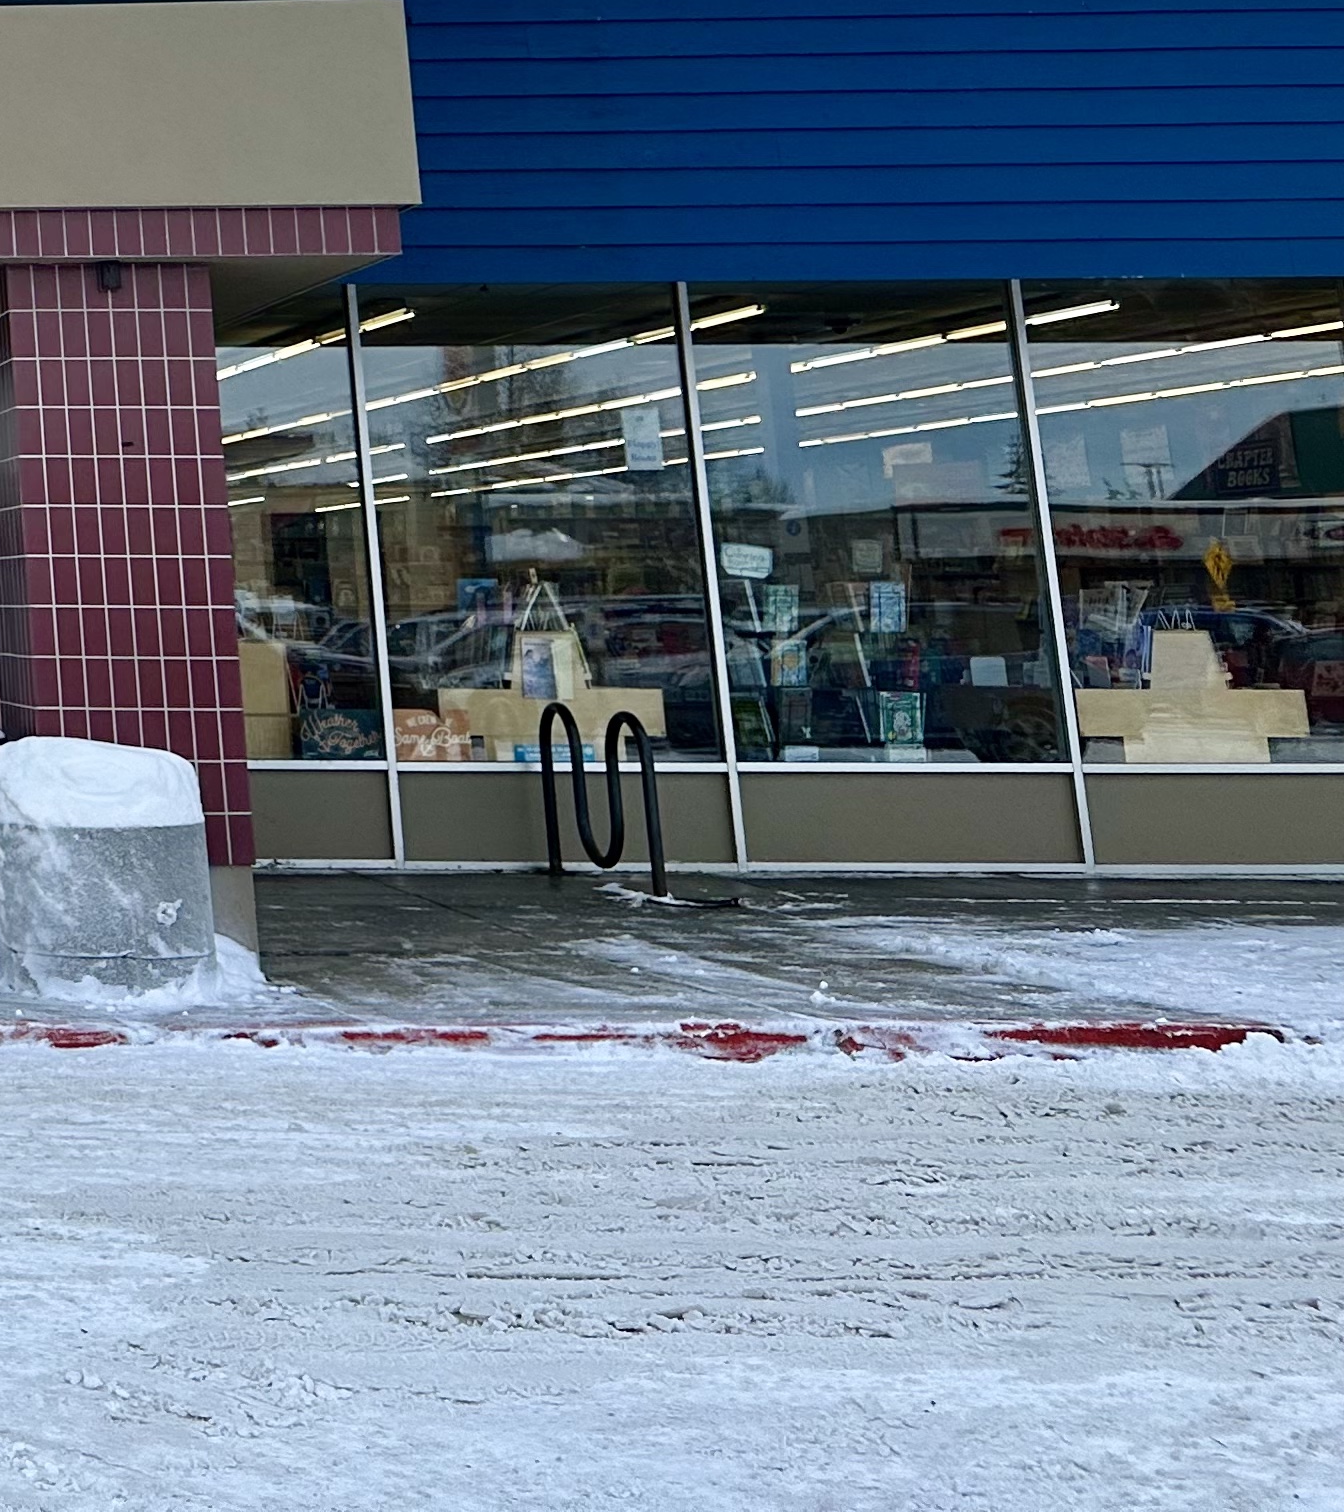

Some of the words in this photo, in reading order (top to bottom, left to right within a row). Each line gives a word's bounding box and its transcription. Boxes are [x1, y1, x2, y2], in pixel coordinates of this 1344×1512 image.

[1227, 467, 1270, 488] BOOKS
[394, 726, 426, 747] Same
[430, 726, 472, 748] Boat
